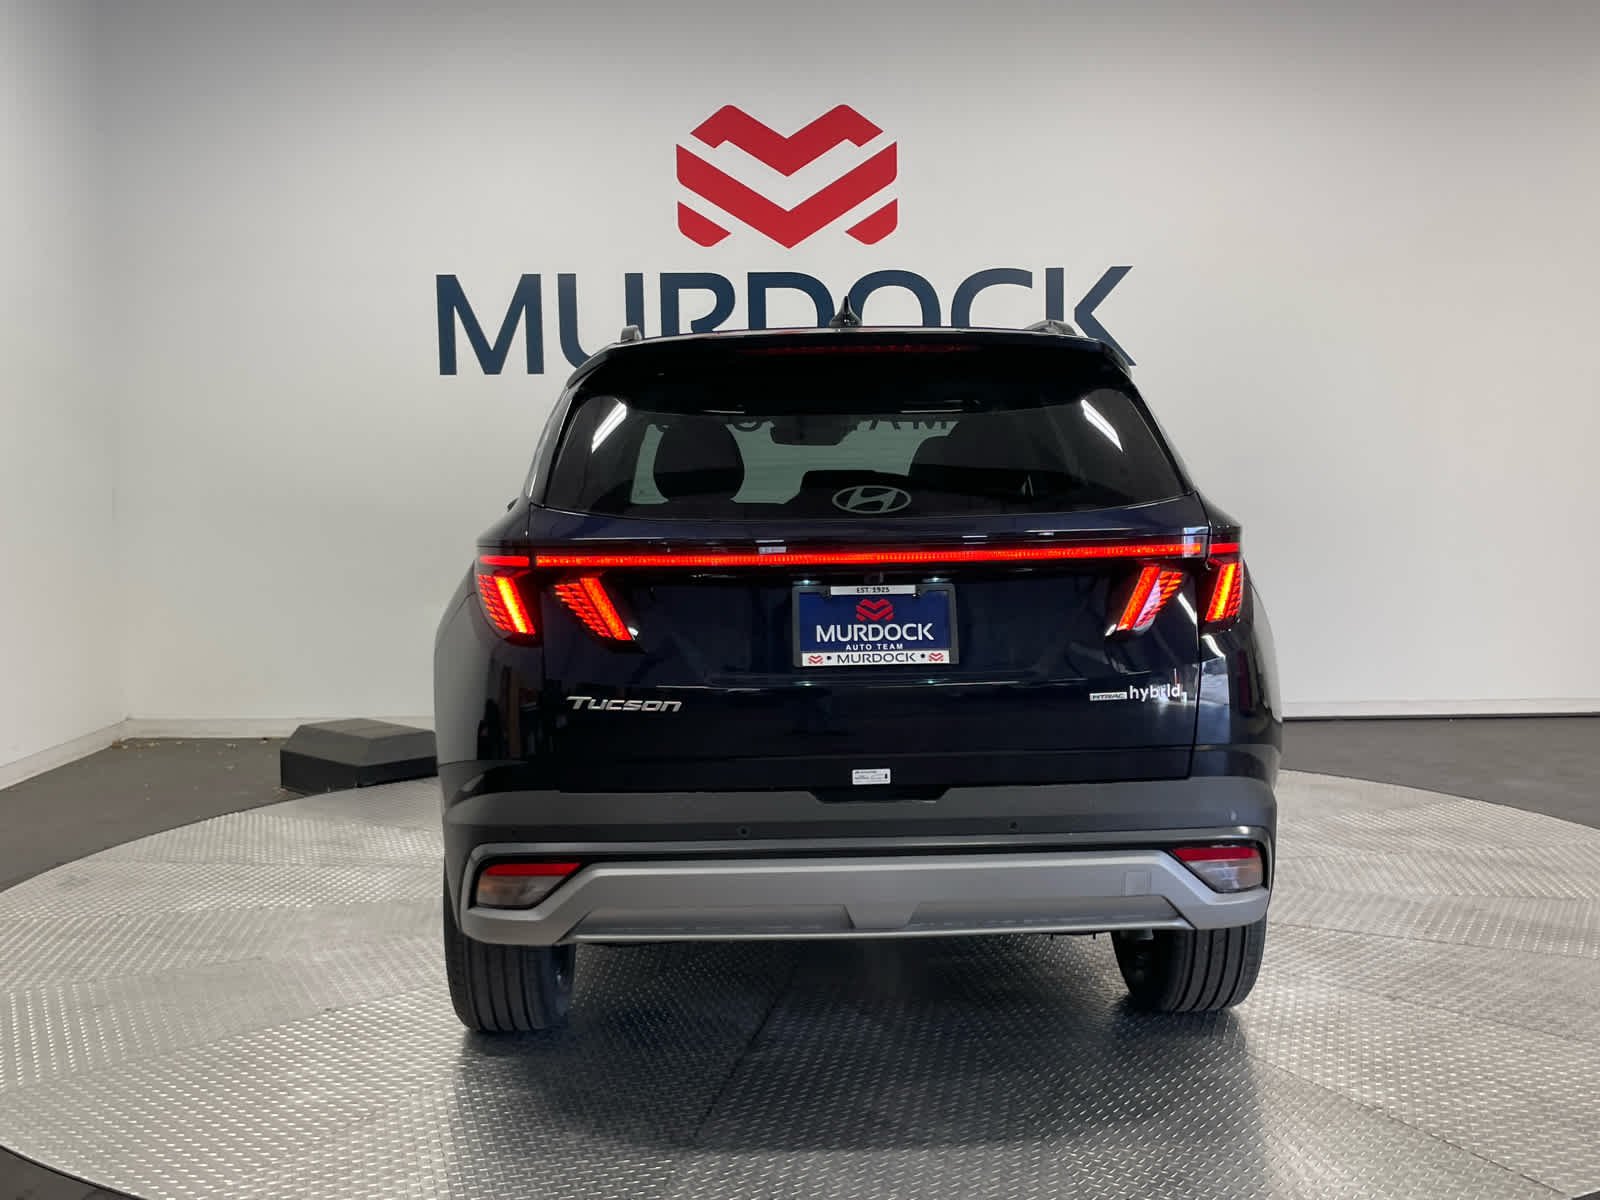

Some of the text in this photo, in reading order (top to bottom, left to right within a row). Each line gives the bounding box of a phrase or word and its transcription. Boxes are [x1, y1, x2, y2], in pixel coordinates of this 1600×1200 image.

[435, 265, 1137, 376] MURDOCK
[816, 622, 935, 643] MURDOCK
[845, 643, 872, 651] AUTO
[836, 652, 917, 665] MURDOCK
[1129, 684, 1181, 702] hybrid
